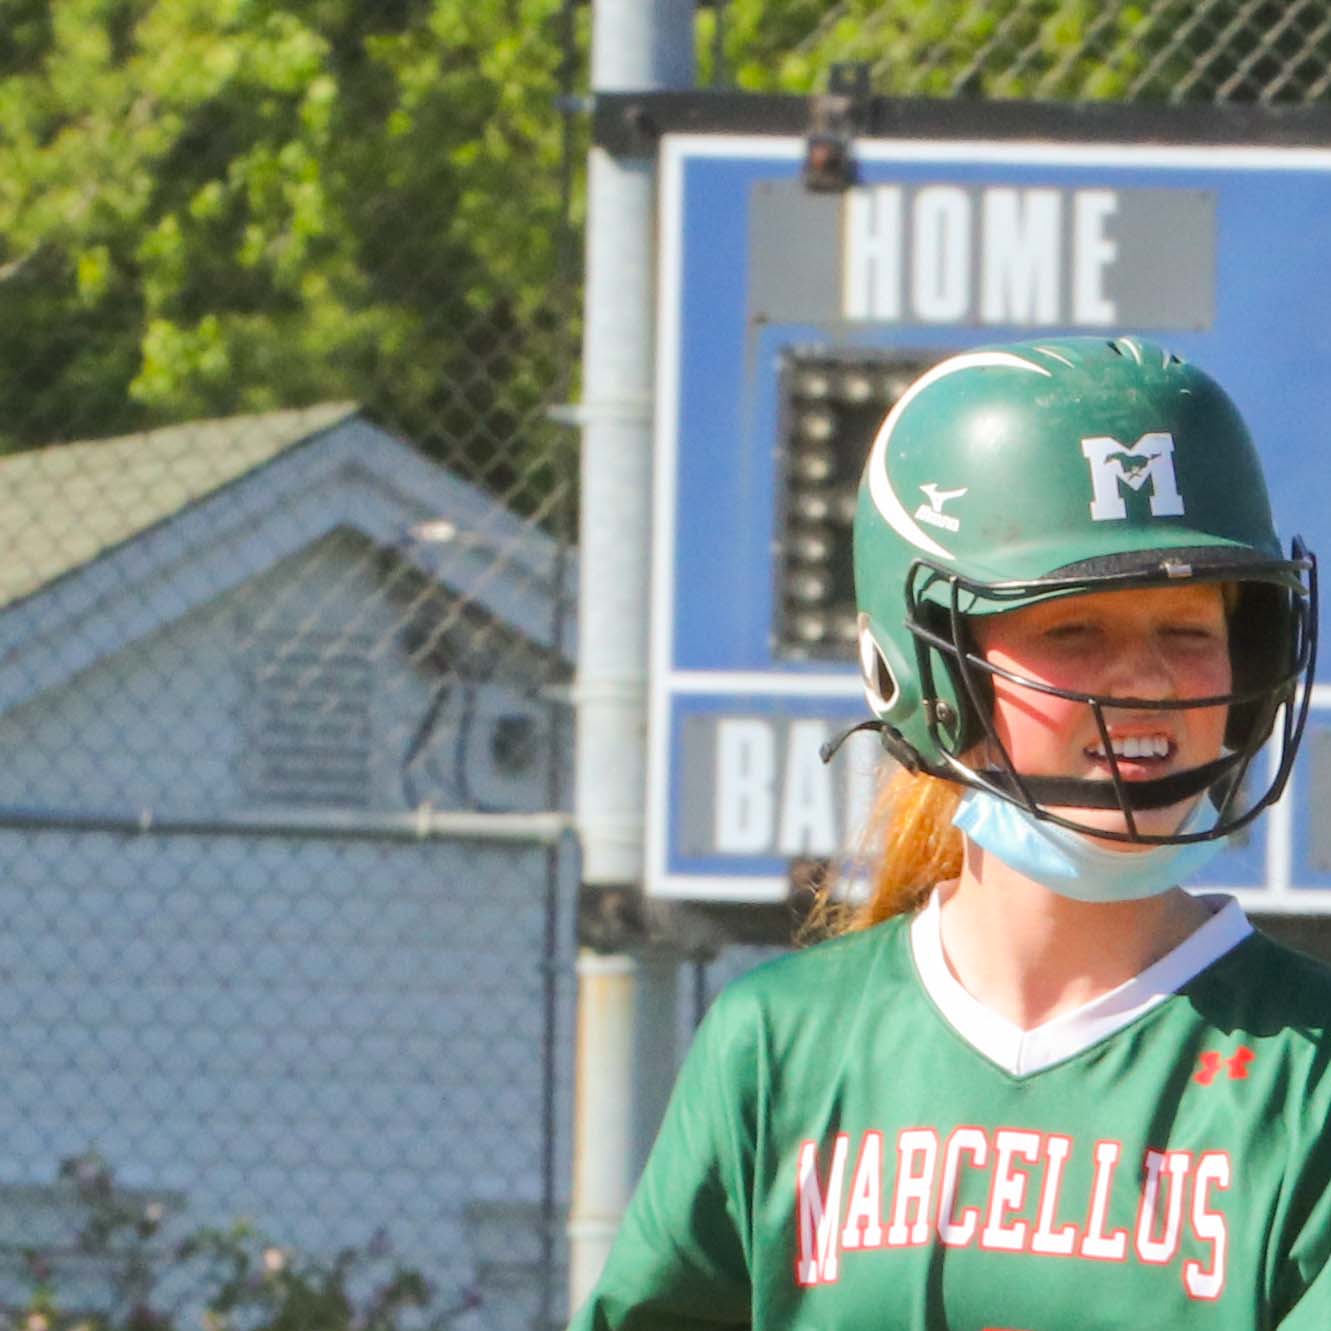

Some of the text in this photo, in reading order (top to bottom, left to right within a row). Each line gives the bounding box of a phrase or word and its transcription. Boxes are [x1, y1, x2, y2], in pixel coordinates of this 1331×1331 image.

[841, 188, 1118, 323] HOME
[1081, 432, 1185, 521] M
[795, 1124, 1232, 1303] MARCELLUS
